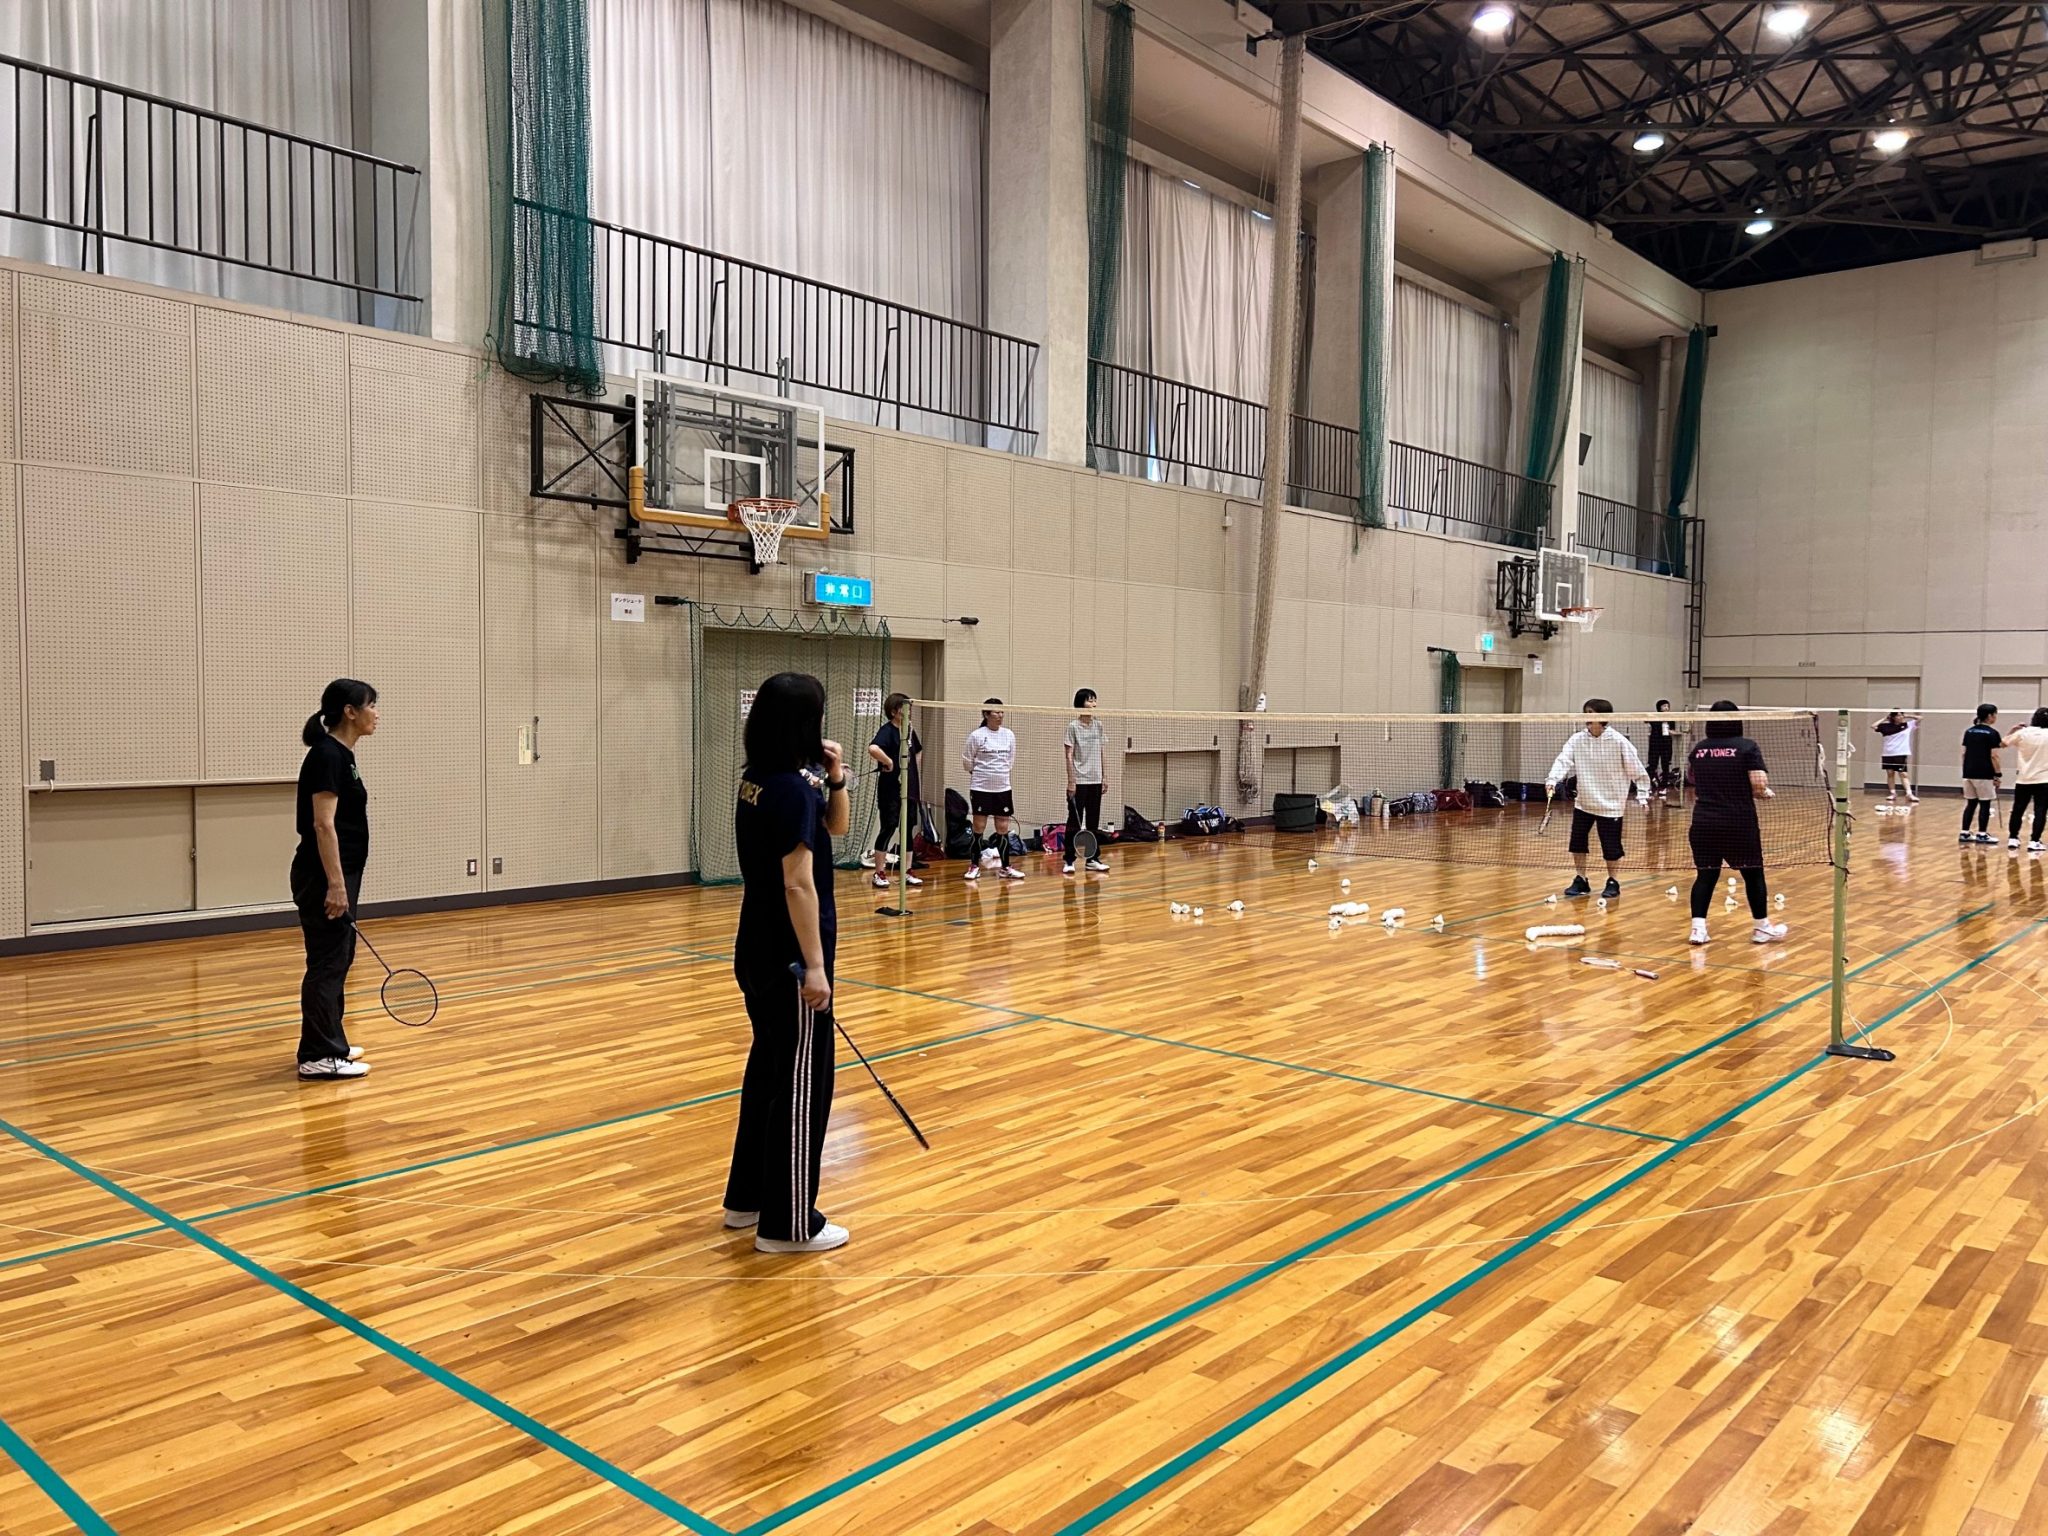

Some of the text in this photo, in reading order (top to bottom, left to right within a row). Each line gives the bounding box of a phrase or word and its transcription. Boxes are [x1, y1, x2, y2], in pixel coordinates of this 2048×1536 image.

[825, 582, 863, 599] 非常口
[1709, 748, 1736, 757] YONEX
